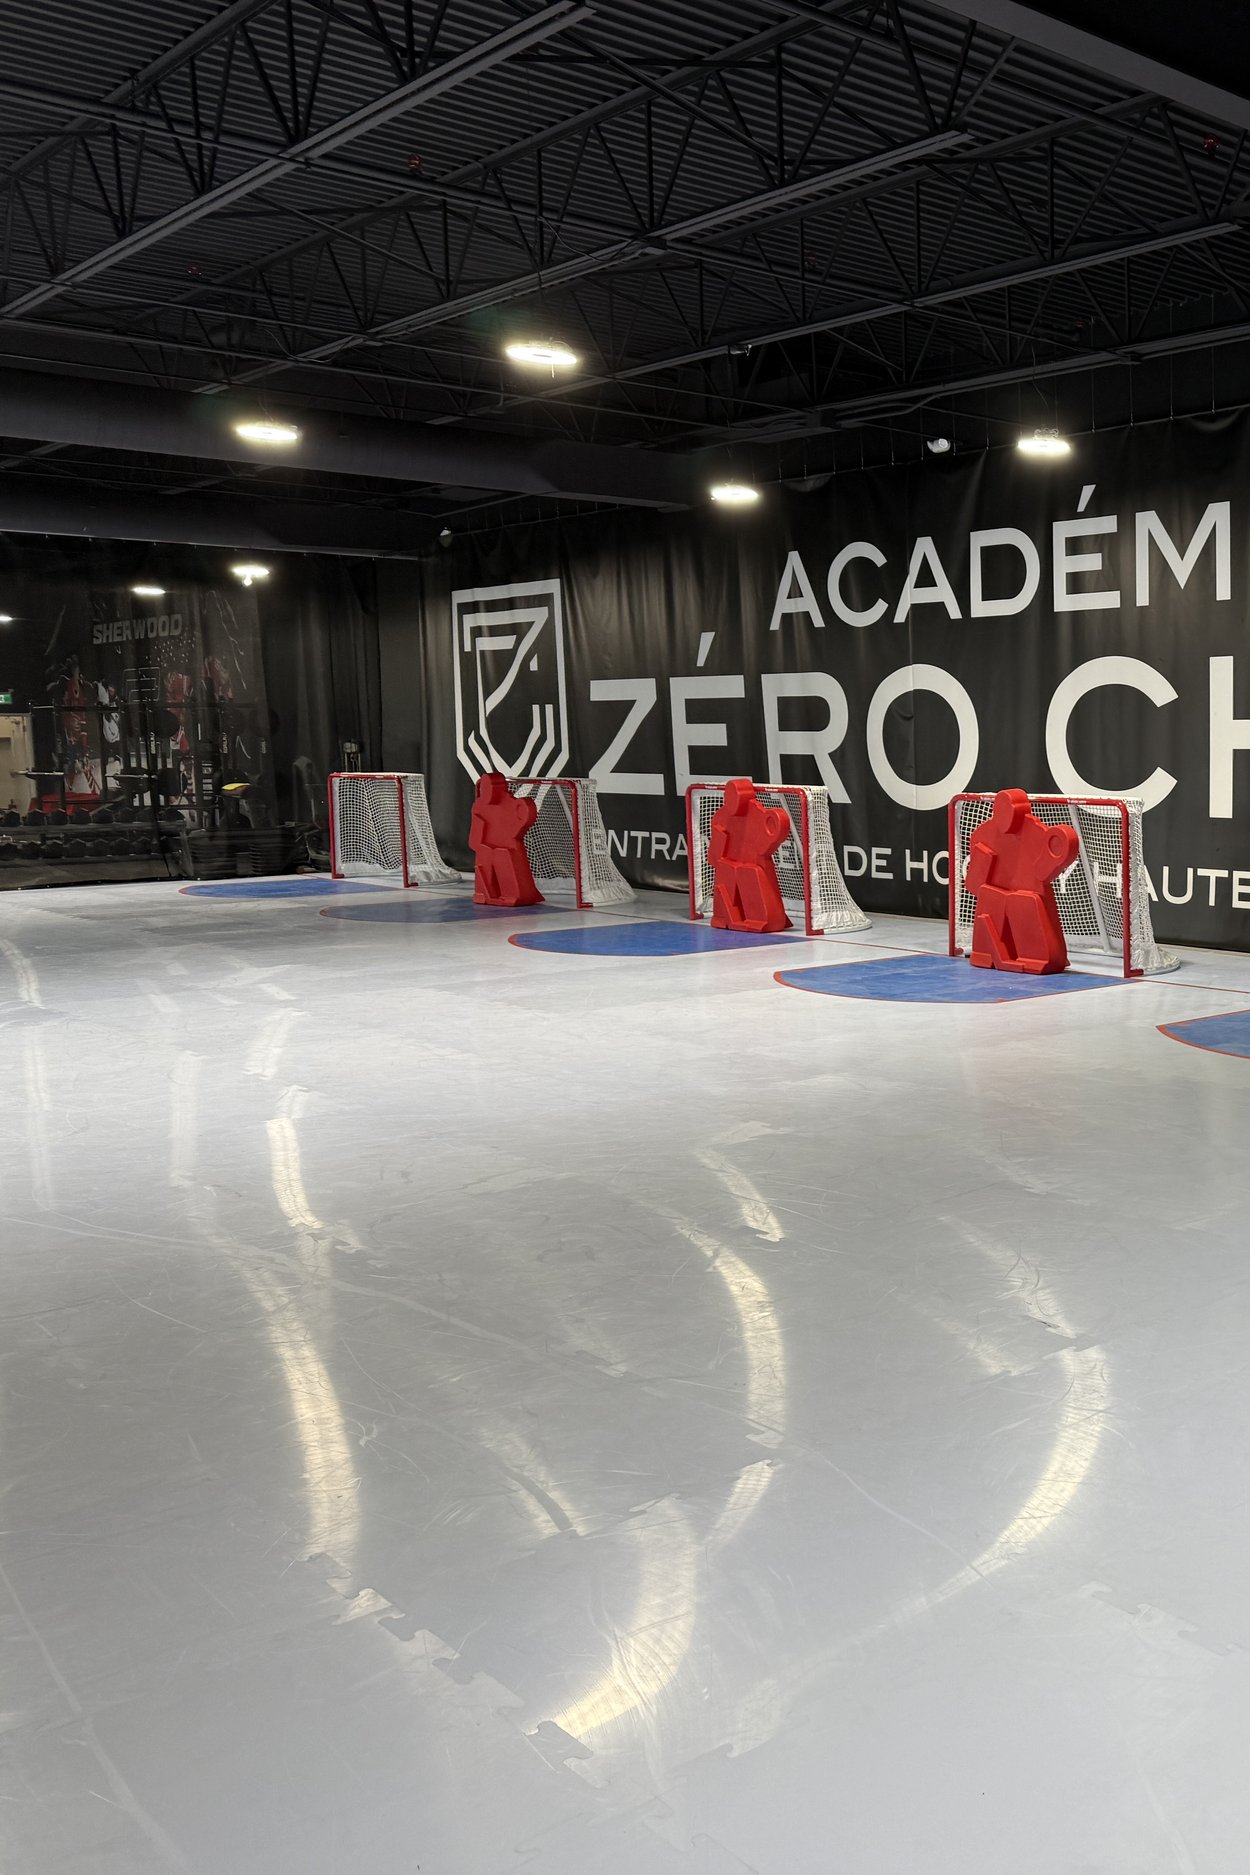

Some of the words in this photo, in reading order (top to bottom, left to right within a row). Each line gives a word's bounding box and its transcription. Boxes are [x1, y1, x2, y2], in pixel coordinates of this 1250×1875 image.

[93, 614, 182, 644] SHERWOOD
[588, 631, 979, 810] ZÉRO
[843, 845, 894, 879] DE
